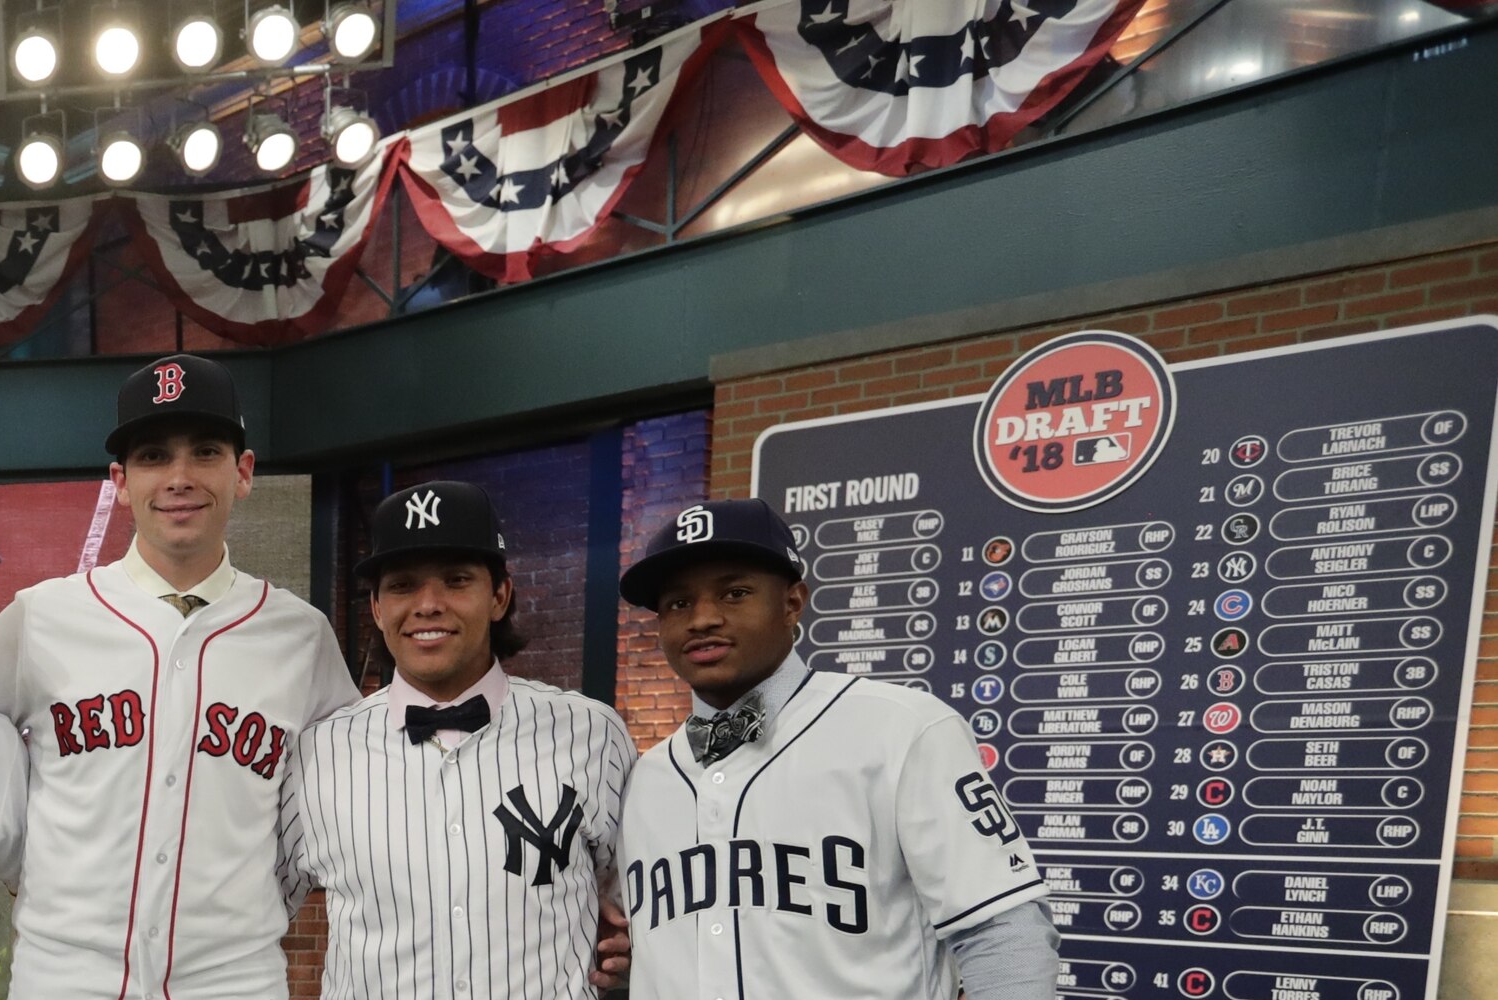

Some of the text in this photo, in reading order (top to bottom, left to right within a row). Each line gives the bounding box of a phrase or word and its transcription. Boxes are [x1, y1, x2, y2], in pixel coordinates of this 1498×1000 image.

[152, 362, 186, 404] B
[1025, 369, 1124, 410] MLB
[995, 396, 1151, 446] DRAFT
[1434, 421, 1452, 435] OF
[1329, 423, 1382, 440] TREVOR
[1322, 436, 1385, 456] LARNACH
[1201, 448, 1220, 465] 20
[1332, 464, 1372, 480] BRICE
[1429, 462, 1450, 476] SS
[785, 472, 920, 514] FIRST ROUND
[1323, 477, 1378, 495] TURANG
[1199, 487, 1215, 503] 21
[404, 489, 442, 531] NY
[1329, 504, 1366, 520] RYAN
[1420, 503, 1448, 518] LHP
[1195, 525, 1213, 540] 22
[1317, 517, 1375, 534] ROLISON
[1060, 530, 1112, 545] GRAYSON
[961, 547, 974, 561] 11
[1055, 542, 1115, 558] RODRIGUEZ
[1311, 544, 1374, 561] ANTHONY
[1060, 566, 1106, 580] JORDAN
[1191, 562, 1209, 578] 23
[1314, 558, 1367, 574] SEIGLER
[958, 581, 973, 595] 12
[1052, 578, 1112, 593] GROSHANS
[1322, 585, 1355, 598] NICO
[1057, 603, 1102, 616] CONNOR
[1188, 600, 1205, 615] 24
[1308, 597, 1368, 612] HOERNER
[956, 616, 970, 629] 13
[1060, 615, 1097, 627] SCOTT
[1316, 624, 1354, 637] MATT
[1059, 638, 1095, 651] LOGAN
[1185, 637, 1202, 652] 25
[1308, 637, 1359, 651] McLAIN
[953, 650, 967, 664] 14
[1054, 651, 1098, 664] GILBERT
[1302, 662, 1359, 676] TRISTON
[1406, 666, 1425, 680] 3B
[1060, 675, 1087, 686] COLE
[1180, 674, 1198, 689] 26
[1306, 676, 1351, 690] CASAS
[951, 683, 965, 697] 15
[1057, 686, 1088, 699] WINN
[1302, 702, 1351, 715] MASON
[1397, 706, 1426, 719] RHP
[1178, 711, 1195, 726] 27
[1290, 715, 1360, 728] DENABURG
[50, 689, 288, 780] RED SOX
[1305, 741, 1339, 754] SETH
[1174, 748, 1191, 763] 28
[1305, 754, 1337, 766] BEER
[1170, 785, 1188, 800] 29
[1300, 780, 1337, 792] NOAH
[1292, 792, 1342, 805] NAYLOR
[1167, 821, 1185, 836] 30
[1302, 818, 1325, 830] J.T.
[492, 782, 584, 887] NY
[1297, 830, 1329, 843] GINN
[627, 835, 871, 935] PADRES
[1162, 876, 1179, 890] 34
[1284, 876, 1328, 890] DANIEL
[1285, 889, 1326, 902] LYNCH
[1158, 910, 1176, 925] 35
[1280, 912, 1323, 924] ETHAN
[1272, 924, 1330, 938] HANKINS
[1154, 972, 1169, 988] 41
[1276, 976, 1318, 990] LENNY
